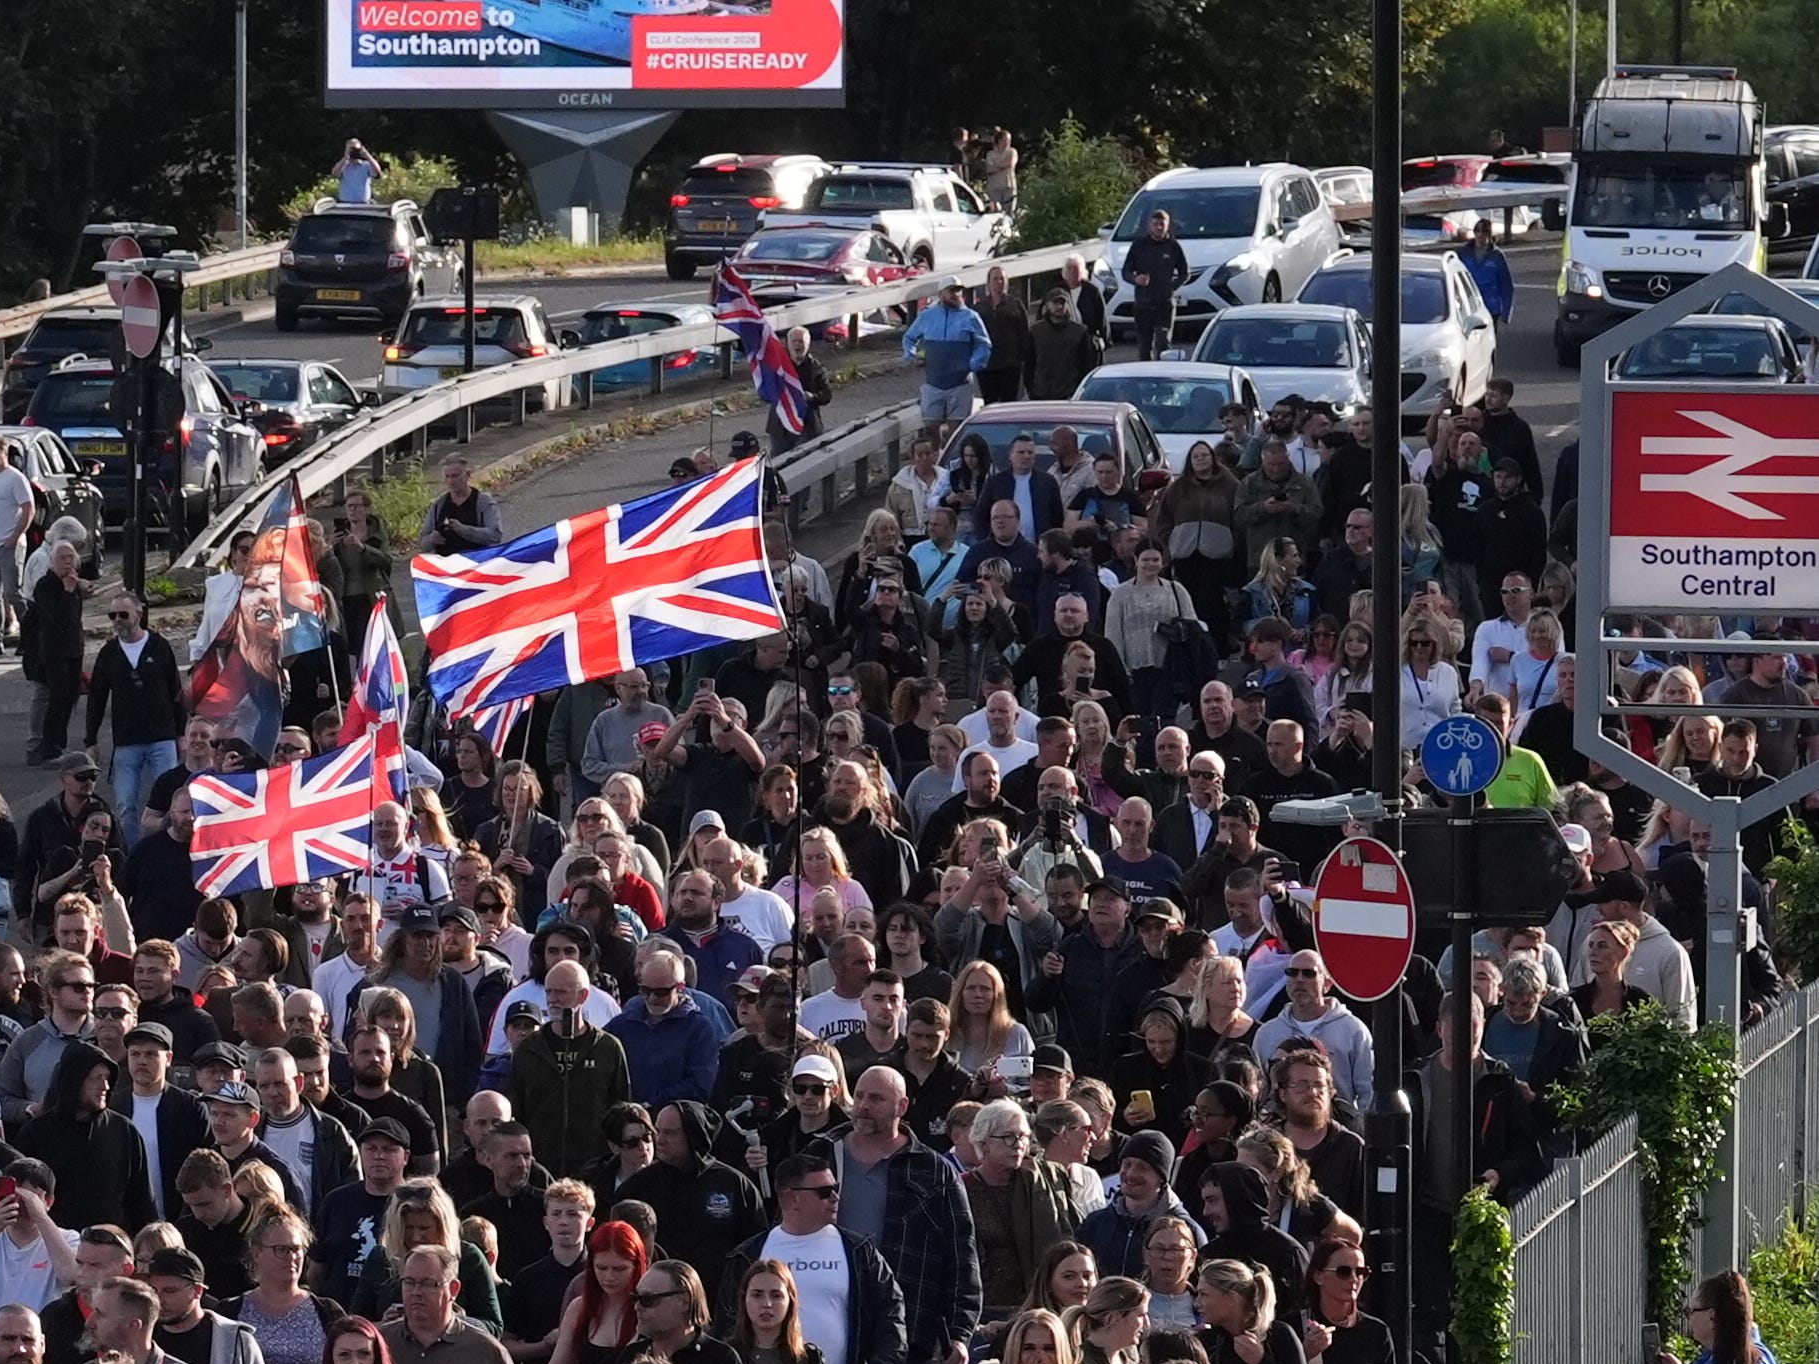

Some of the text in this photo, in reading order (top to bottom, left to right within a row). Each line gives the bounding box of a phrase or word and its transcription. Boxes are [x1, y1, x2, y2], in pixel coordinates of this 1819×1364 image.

[359, 4, 515, 27] Welcome to
[358, 34, 540, 60] Southampton
[646, 53, 808, 71] #CRUISEREADY
[558, 92, 613, 106] OCEAN
[1642, 543, 1817, 570] Southampton
[1681, 574, 1775, 597] Central
[819, 1019, 867, 1040] CALIFOR
